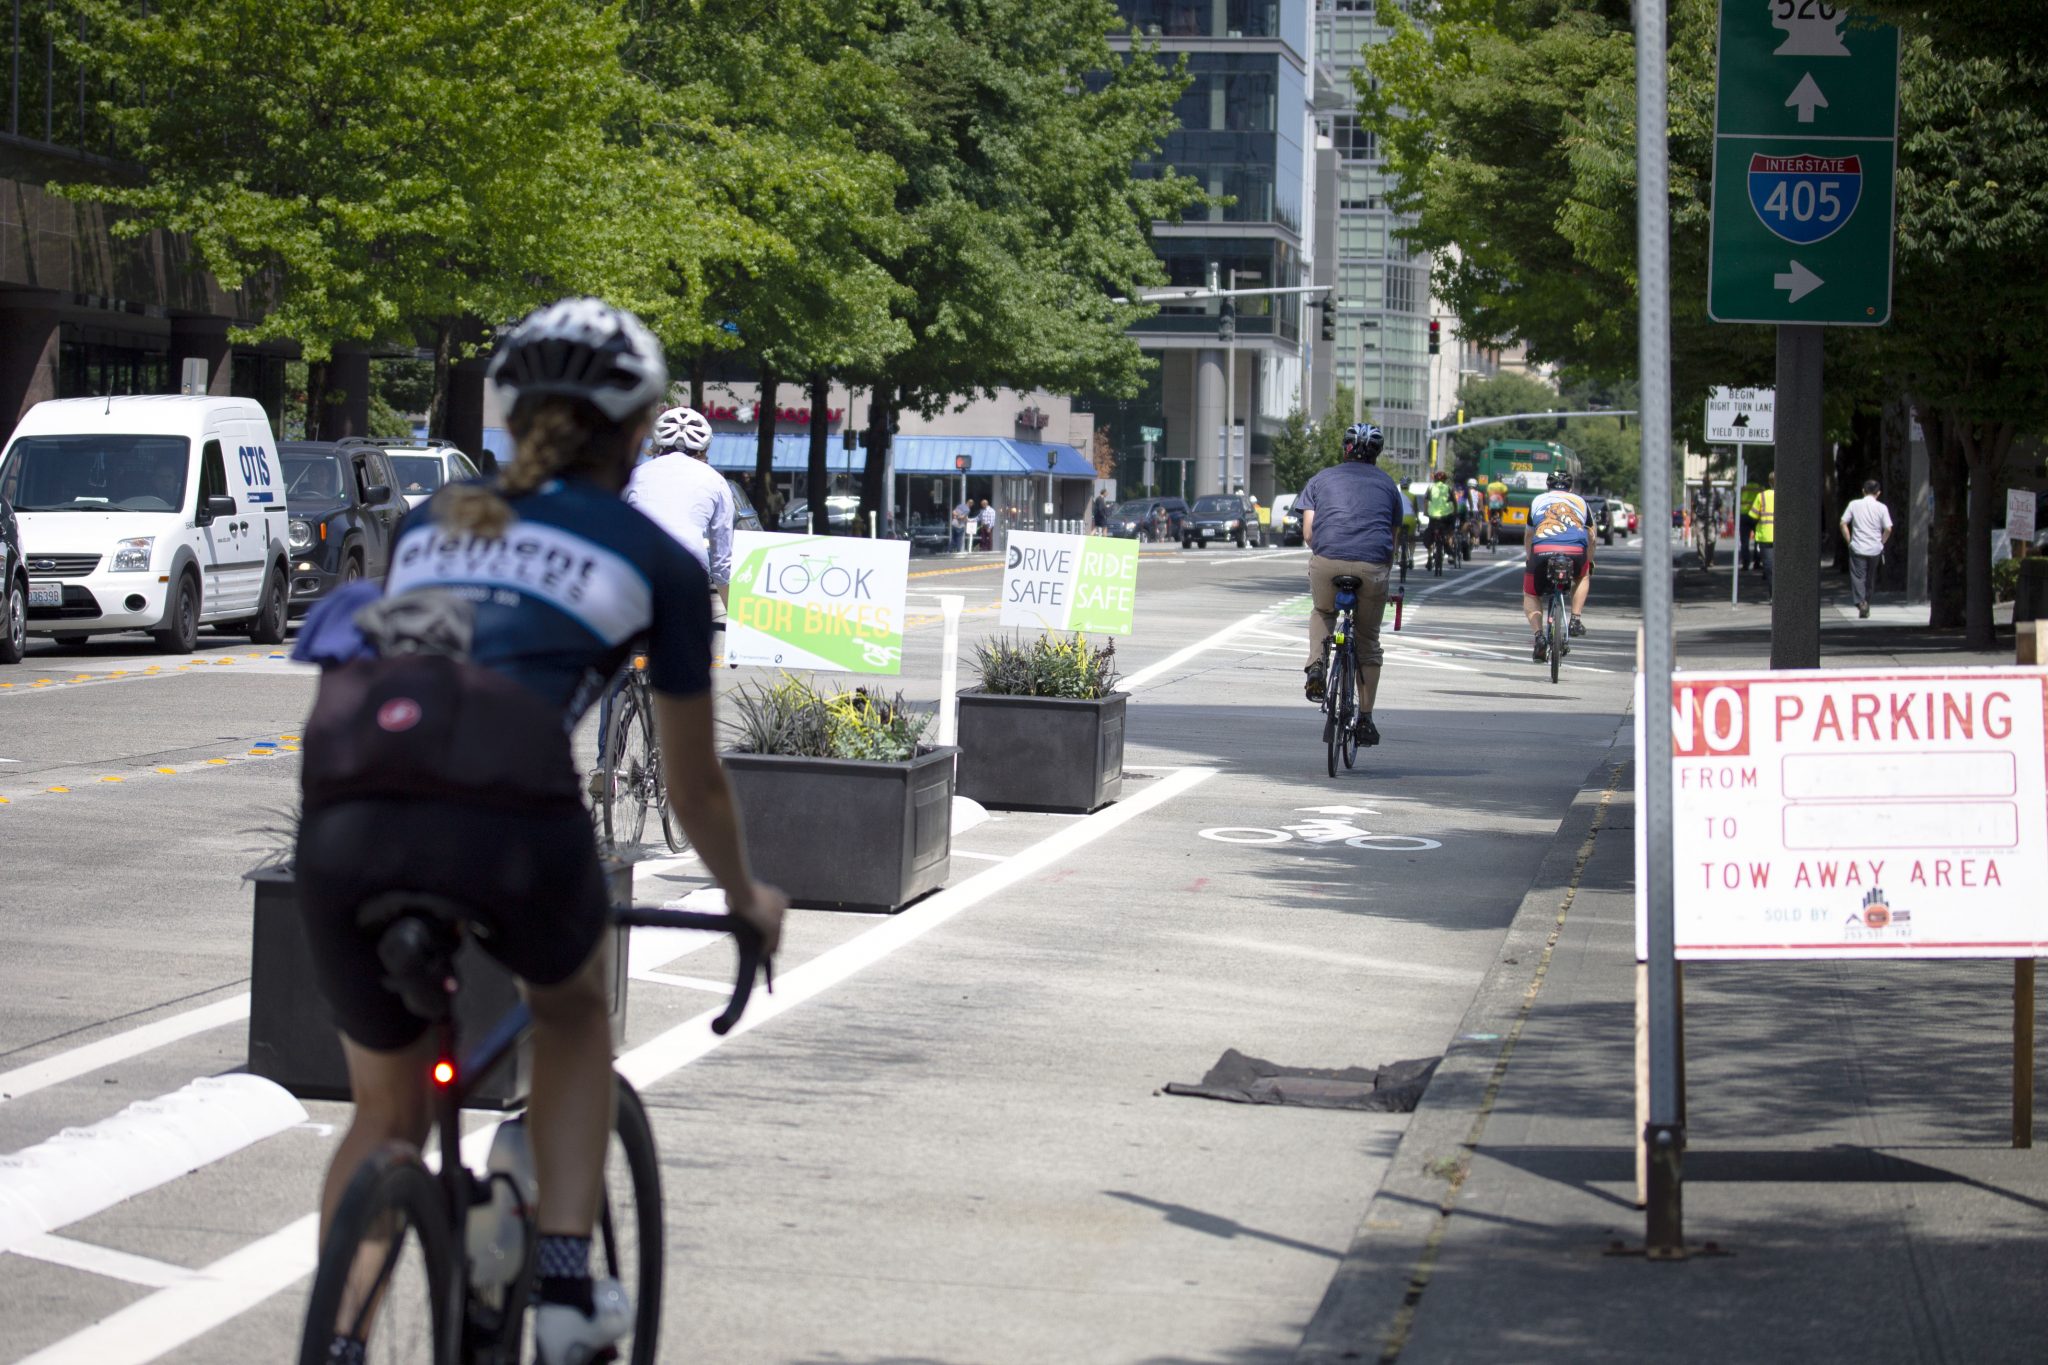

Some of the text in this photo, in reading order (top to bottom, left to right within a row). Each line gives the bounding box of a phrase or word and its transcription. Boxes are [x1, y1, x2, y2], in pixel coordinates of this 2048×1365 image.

[1766, 159, 1845, 172] INTERSTATE
[1764, 180, 1841, 222] 405
[1710, 401, 1773, 412] RIGHT TURN LANE
[1729, 390, 1754, 399] BEGIN
[1712, 427, 1770, 438] YIELD TO BIKES
[239, 445, 271, 487] OTIS
[1008, 544, 1072, 574] DRIVE
[1083, 551, 1136, 579] RIDE
[765, 562, 874, 599] LOOK
[1008, 579, 1064, 606] SAFE
[1076, 583, 1132, 612] SAFE
[738, 597, 891, 639] FOR BIKES
[1672, 686, 2013, 752] NO PARKING
[1681, 767, 1758, 789] FROM
[1705, 817, 1738, 840] TO
[1701, 859, 2002, 889] TOW AWAY AREA
[1764, 909, 1802, 923] SOLD
